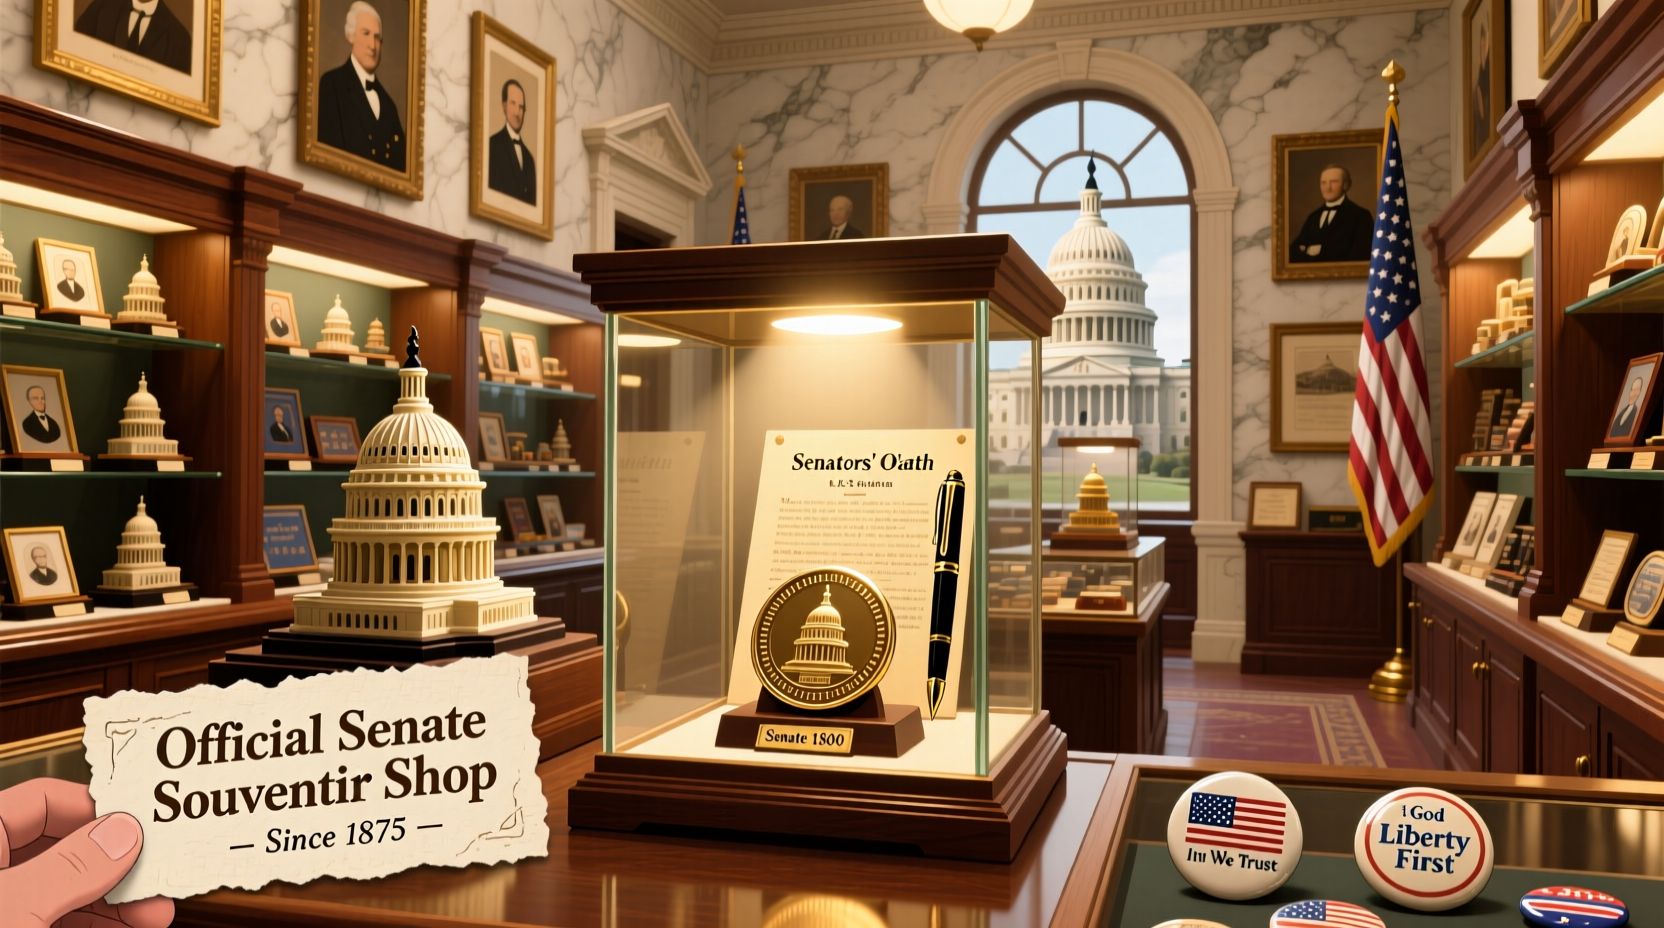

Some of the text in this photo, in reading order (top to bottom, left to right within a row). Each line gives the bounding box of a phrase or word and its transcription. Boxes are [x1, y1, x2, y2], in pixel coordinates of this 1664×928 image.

[792, 452, 876, 471] Senators'
[156, 706, 486, 769] Official Senate
[813, 732, 844, 746] 1800
[153, 754, 497, 822] Souventir Shop
[1410, 805, 1445, 822] God
[265, 817, 406, 853] Since 1875
[1379, 823, 1471, 857] Liberty
[1210, 849, 1234, 867] We
[1238, 853, 1278, 872] Trust
[1394, 848, 1455, 874] First
